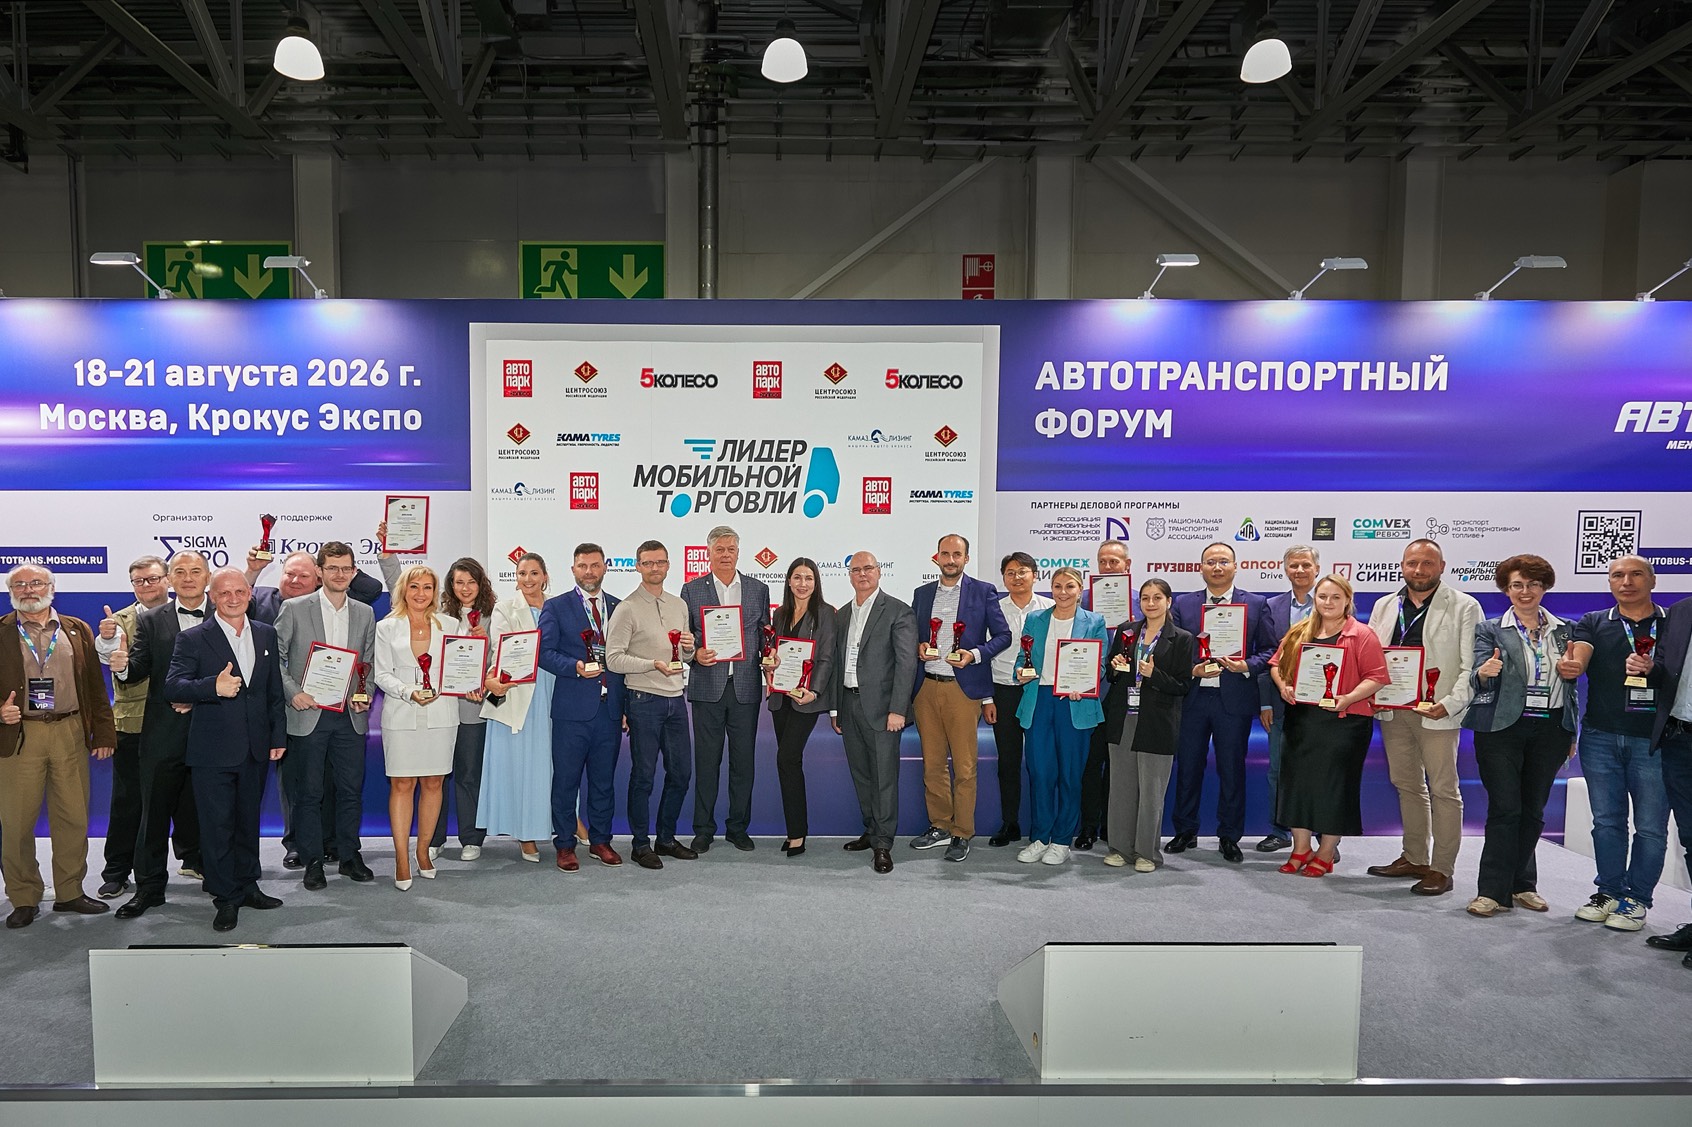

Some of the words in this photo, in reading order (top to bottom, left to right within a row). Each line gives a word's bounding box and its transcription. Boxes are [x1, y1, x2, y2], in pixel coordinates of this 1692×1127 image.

[505, 362, 529, 374] авто
[755, 363, 779, 376] авто
[1034, 354, 1449, 392] АВТОТРАНСПОРТНЫЙ
[165, 363, 298, 391] августа
[307, 358, 389, 387] 2026
[399, 364, 421, 387] г.
[505, 375, 531, 390] парк
[755, 376, 780, 392] парк
[39, 403, 178, 435] Москва,
[188, 403, 309, 435] Крокус
[318, 403, 422, 431] Экспо
[1034, 408, 1173, 438] ФОРУМ
[557, 433, 590, 442] KAMA
[591, 433, 621, 442] TYRES
[717, 440, 808, 463] ЛИДЕР
[572, 475, 596, 488] авто
[633, 464, 802, 488] МОБИЛЬНОЙ
[865, 480, 889, 492] авто
[572, 488, 597, 503] парк
[865, 492, 890, 507] парк
[910, 490, 943, 498] KAMA
[943, 490, 973, 498] TYRES
[1030, 502, 1078, 510] ПАРТНЕРЫ
[1080, 501, 1122, 510] ДЕЛОВОЙ
[1124, 502, 1180, 510] ПРОГРАММЫ
[152, 514, 214, 523] Организатор
[280, 515, 333, 523] поддержке
[1353, 519, 1411, 528] COMVEX
[183, 536, 227, 548] SIGMA
[0, 556, 103, 565] TOTRANS.MOSCOW.RU
[1241, 560, 1283, 570] ancor
[1645, 557, 1692, 565] UTOBUS-
[1147, 563, 1201, 572] ГРУЗОВО
[1260, 572, 1283, 580] Drive
[1356, 571, 1403, 582] СИНЕР
